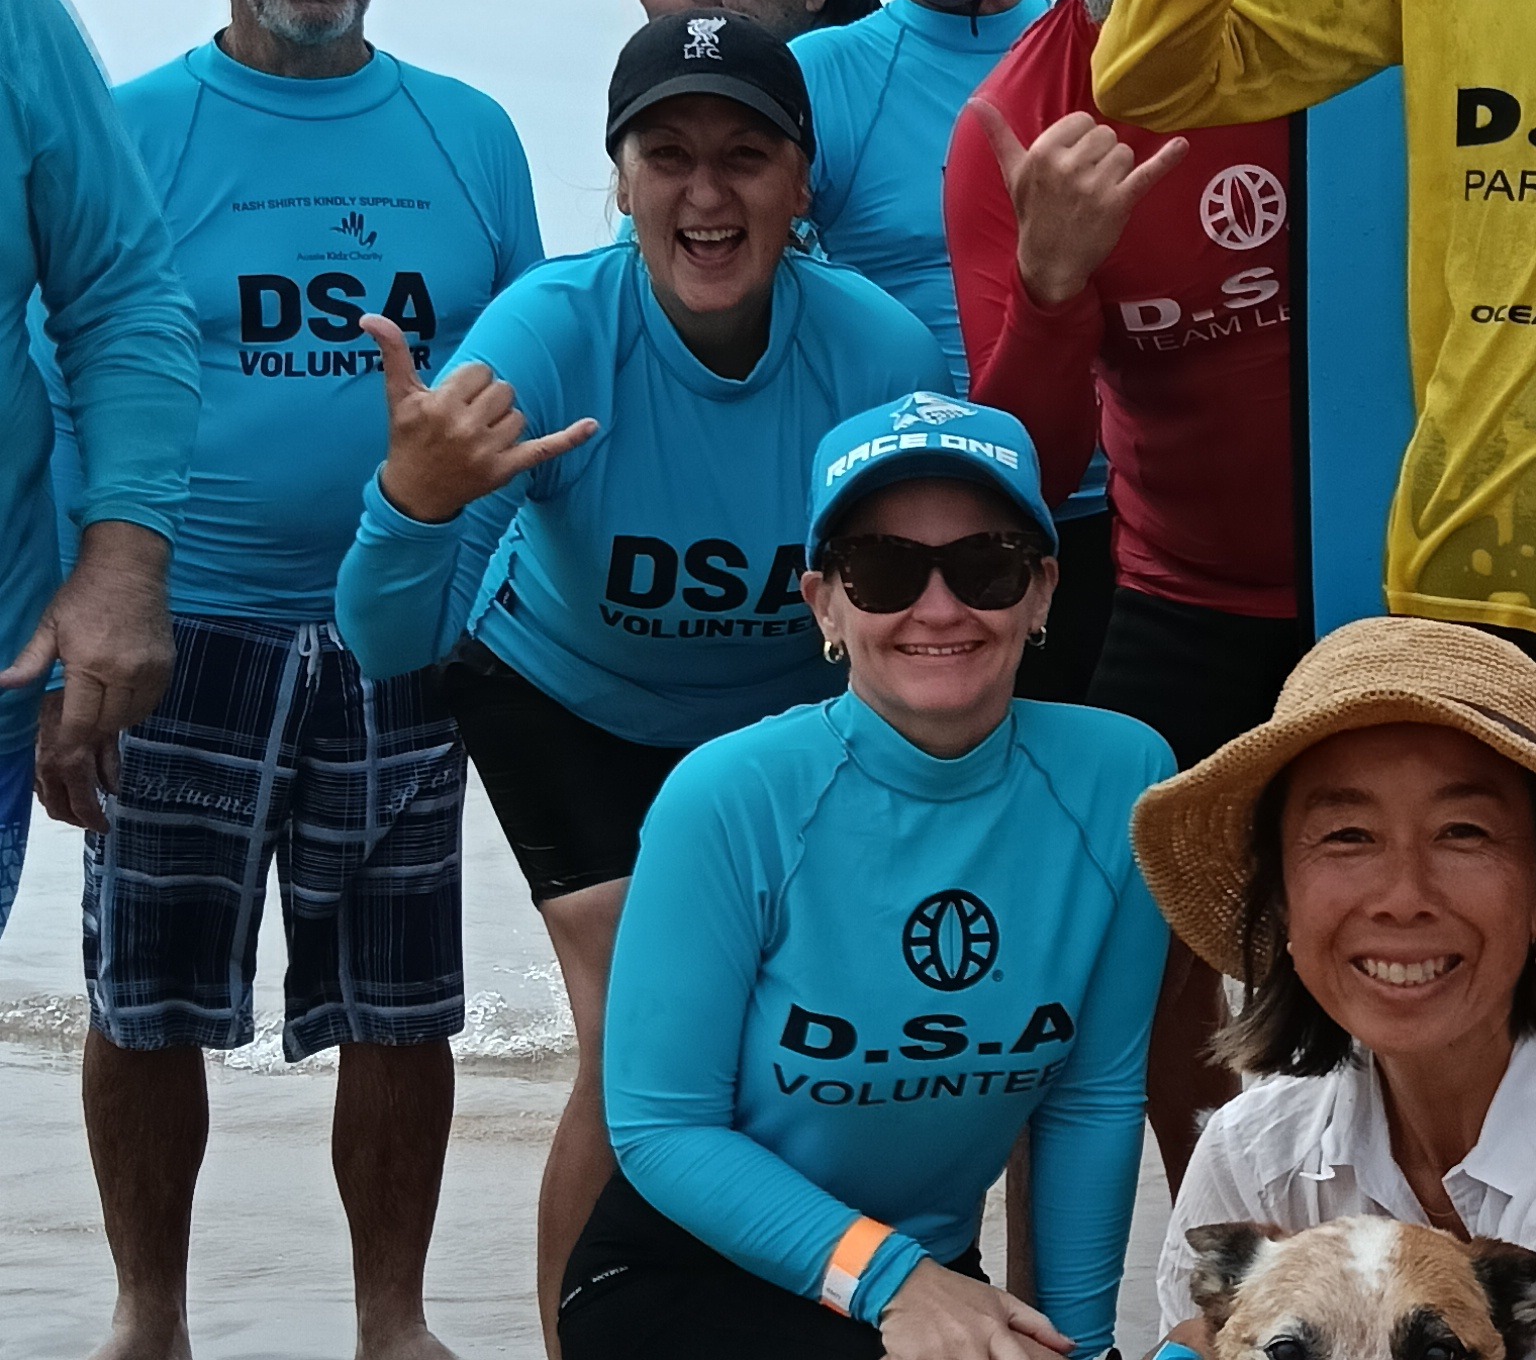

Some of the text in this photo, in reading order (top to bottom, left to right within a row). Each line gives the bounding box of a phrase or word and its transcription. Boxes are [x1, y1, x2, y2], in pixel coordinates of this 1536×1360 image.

[683, 48, 723, 60] LFC
[232, 196, 431, 213] RASH SHIRTS KINDLY SUPPLIED BY
[238, 271, 437, 343] DSA
[1127, 315, 1242, 352] TEAM
[239, 346, 431, 378] VOLUNTR
[826, 433, 1019, 487] RACE ONE
[605, 535, 812, 615] DSA
[599, 603, 812, 639] VOLUNTEE
[773, 1057, 1067, 1107] VOLUNTEE
